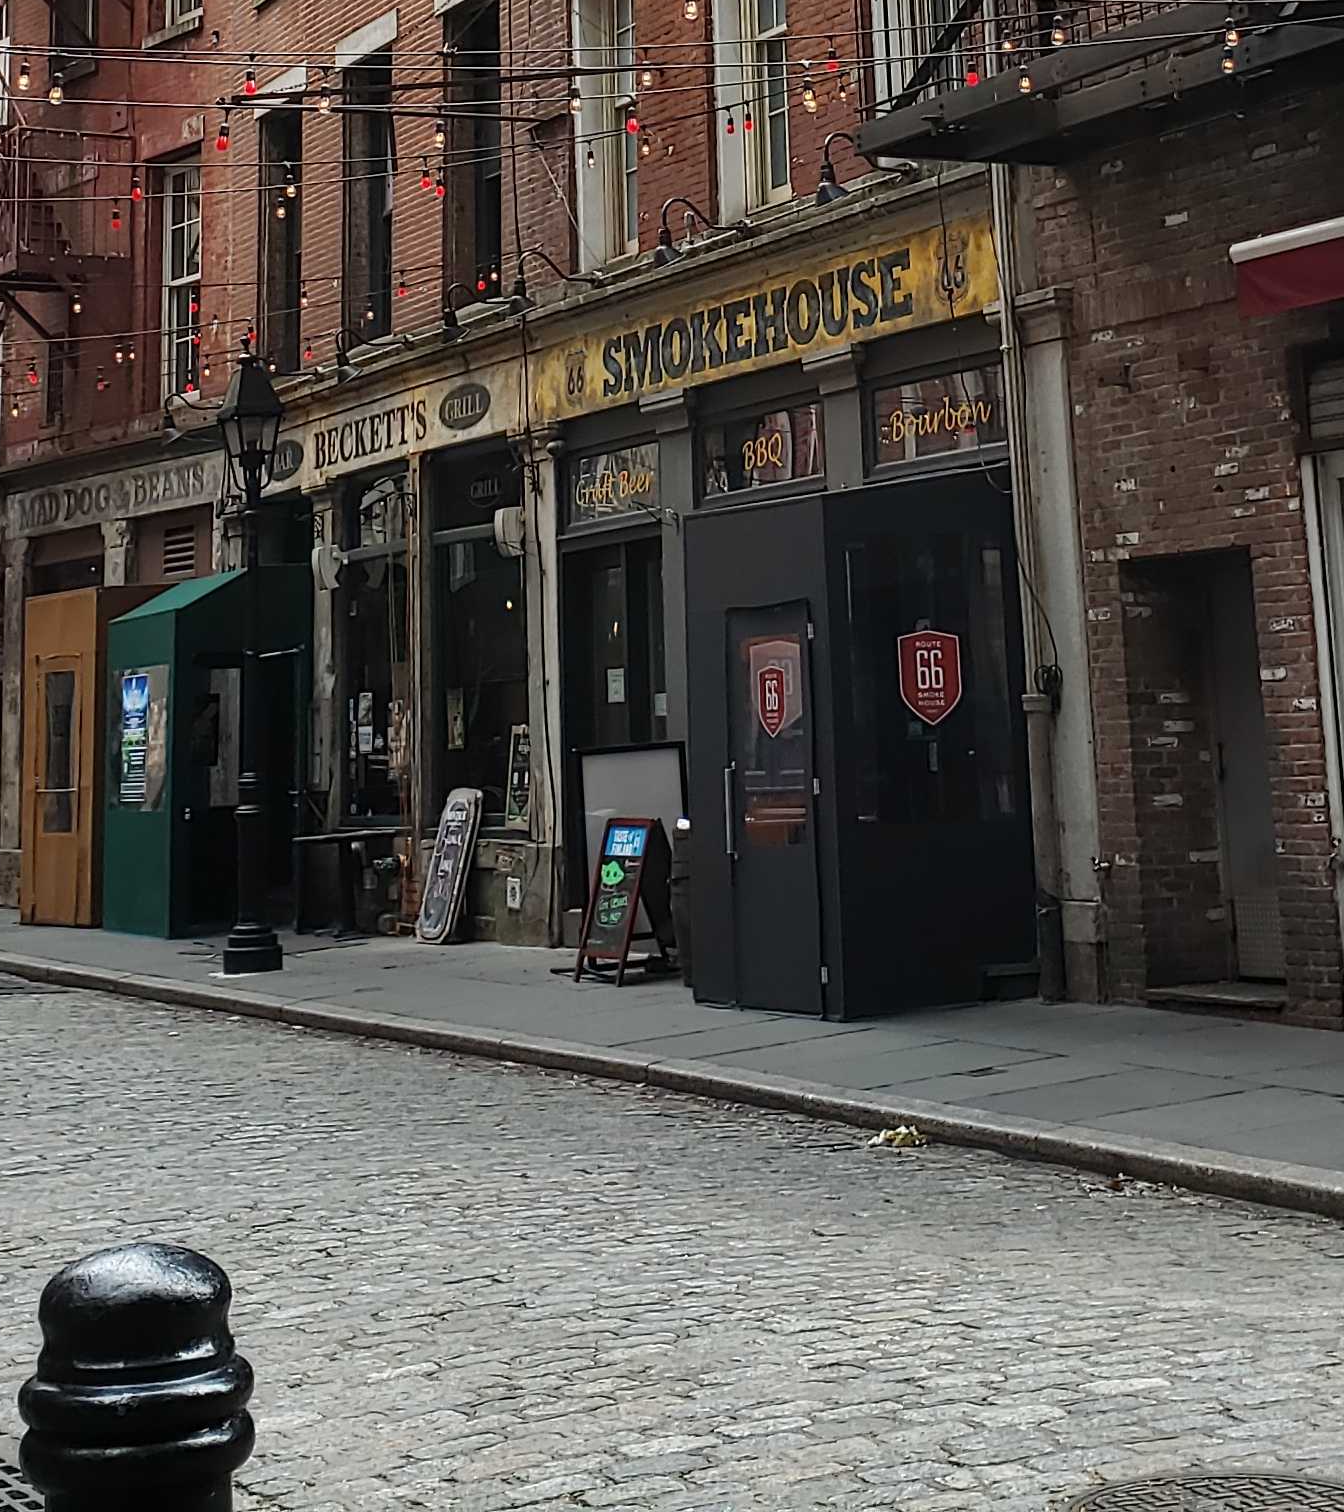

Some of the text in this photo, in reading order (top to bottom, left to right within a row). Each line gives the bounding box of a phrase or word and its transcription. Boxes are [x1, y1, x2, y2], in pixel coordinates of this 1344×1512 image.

[601, 247, 914, 398] SMOKEHOUSE
[313, 399, 428, 470] BECKETT'S
[444, 391, 484, 421] GRILL
[889, 396, 993, 443] Bourbon
[741, 433, 784, 472] BBQ
[18, 491, 58, 531] MAD
[63, 484, 110, 522] DOG
[131, 464, 205, 508] BEANS
[618, 469, 654, 497] Beer
[915, 640, 942, 648] ROUTE
[916, 649, 945, 690] 66
[765, 679, 780, 711] 66
